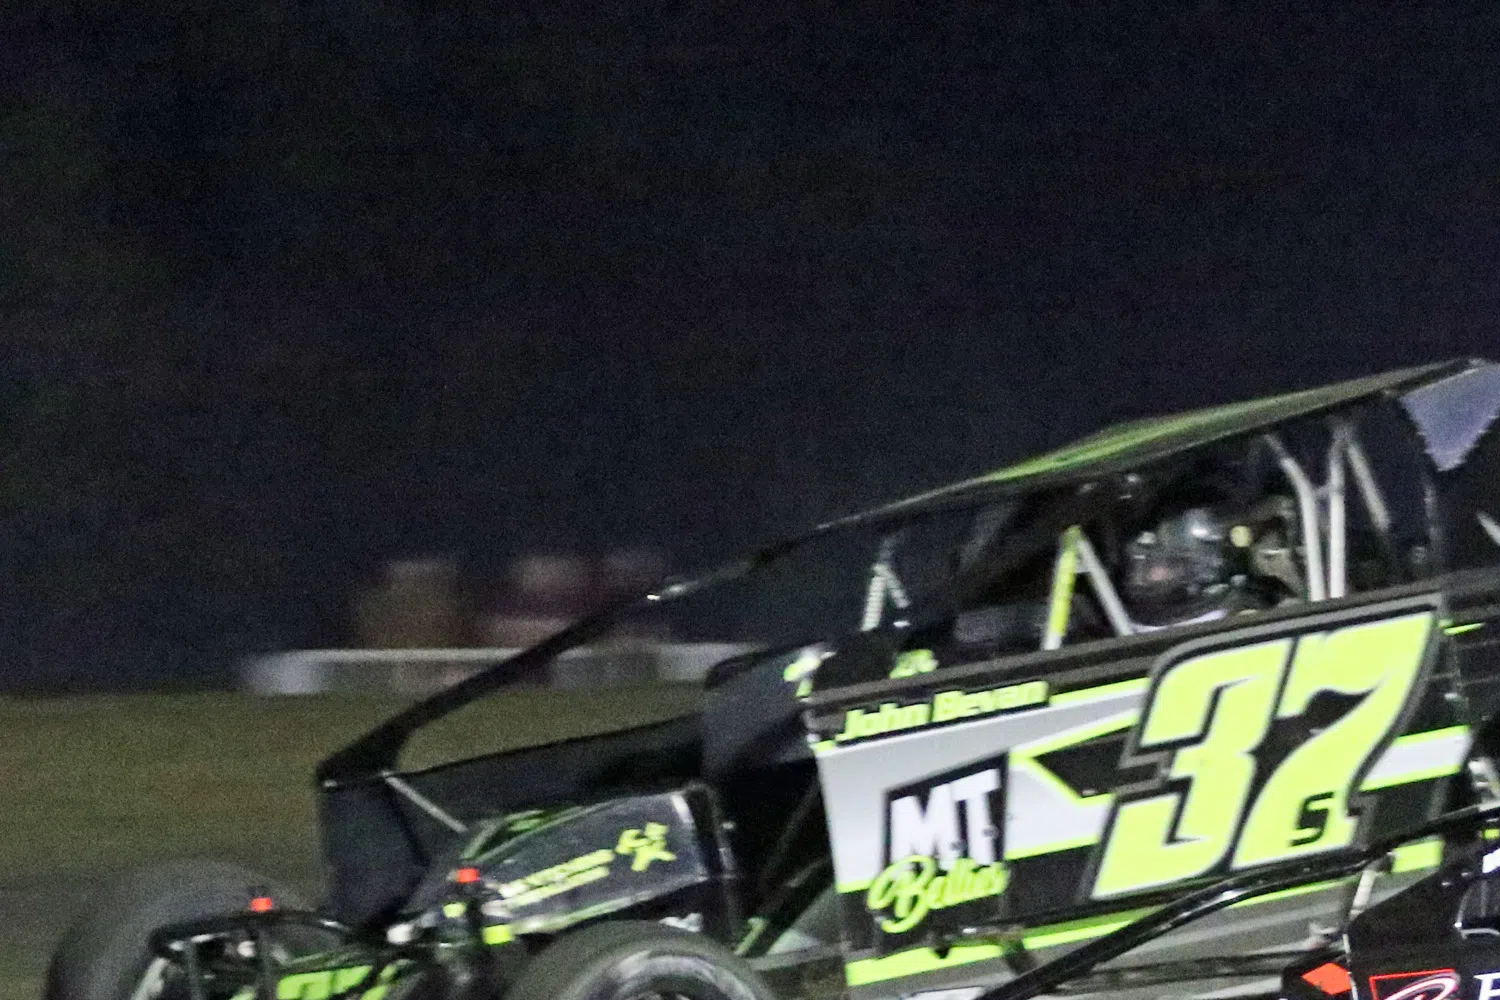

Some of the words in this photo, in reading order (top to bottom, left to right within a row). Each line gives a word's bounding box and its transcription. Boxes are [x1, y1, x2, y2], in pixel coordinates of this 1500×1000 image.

[835, 702, 931, 742] John
[932, 680, 1049, 724] Bevan
[1091, 610, 1435, 899] 37
[890, 767, 1000, 869] MT
